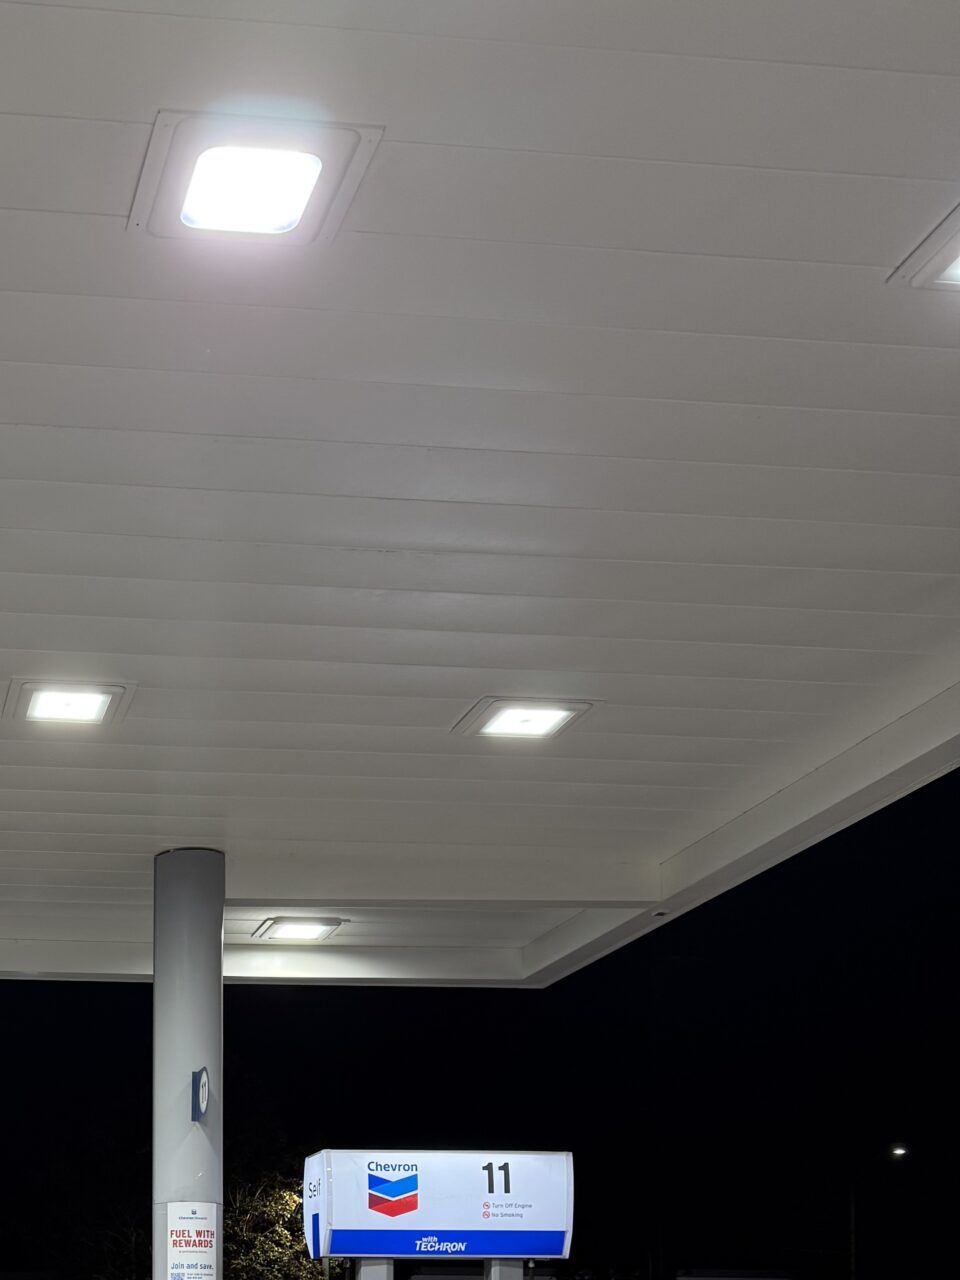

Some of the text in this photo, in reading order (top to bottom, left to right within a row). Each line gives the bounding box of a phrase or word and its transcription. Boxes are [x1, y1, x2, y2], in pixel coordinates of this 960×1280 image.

[367, 1161, 418, 1172] Chevron
[482, 1162, 511, 1194] 11
[308, 1178, 321, 1199] Self
[170, 1229, 215, 1239] FUEL WITH
[172, 1240, 214, 1249] REWARDS
[415, 1241, 466, 1253] TECHRON
[171, 1262, 185, 1270] Join
[186, 1262, 198, 1270] and
